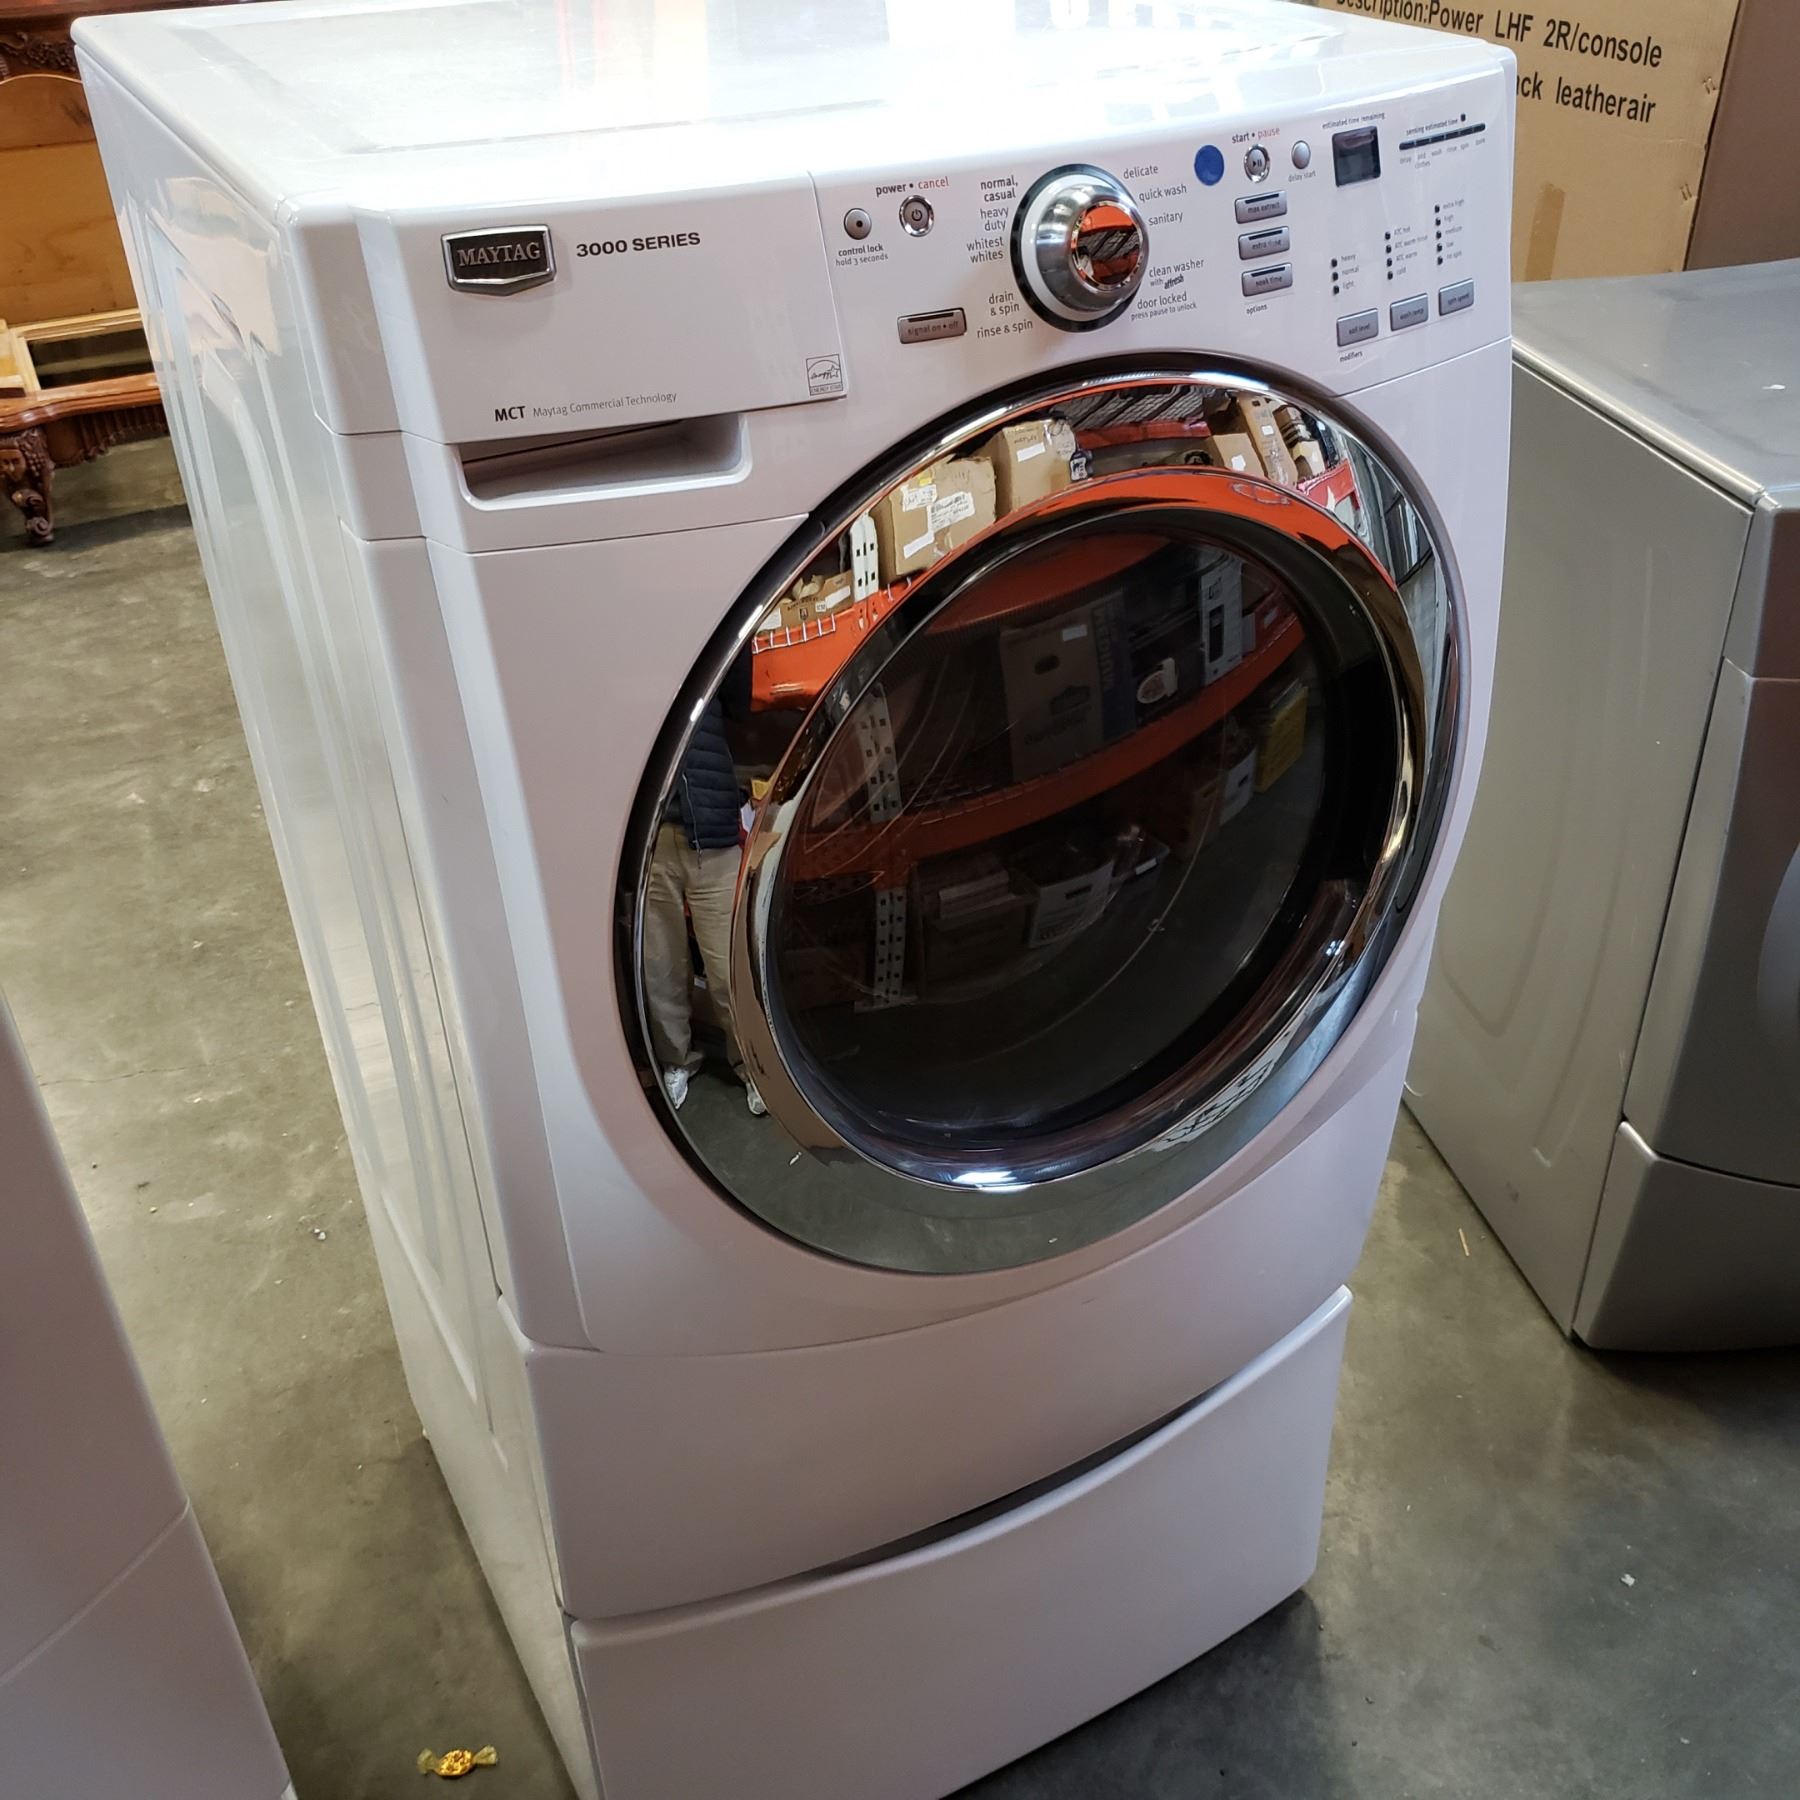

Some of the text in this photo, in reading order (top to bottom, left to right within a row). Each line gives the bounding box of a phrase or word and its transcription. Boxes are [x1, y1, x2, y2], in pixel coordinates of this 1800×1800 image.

[1494, 9, 1534, 42] LHF
[1543, 19, 1662, 68] 2R/console
[1516, 72, 1657, 123] ck leatherair
[1348, 117, 1359, 125] time
[1232, 127, 1280, 144] start pause
[1123, 165, 1158, 180] delicate
[1288, 170, 1316, 182] delay start
[875, 176, 949, 197] power cancel
[980, 175, 1019, 190] normal,
[983, 188, 1016, 202] casual
[1139, 183, 1187, 202] quick wash
[980, 206, 1009, 220] heavy
[1248, 202, 1280, 213] max extract
[984, 218, 1006, 232] duty
[1148, 210, 1183, 226] sanitary
[576, 232, 701, 258] 3000 SERIES
[838, 243, 884, 257] control lock
[966, 236, 1004, 251] whitest
[458, 241, 541, 267] MAYTAG
[835, 253, 889, 267] hold 3 seconds
[970, 249, 1004, 264] whites
[1341, 254, 1356, 263] heavy
[1149, 258, 1205, 278] clean washer
[1342, 266, 1360, 276] normal
[1150, 278, 1164, 286] with
[988, 290, 1014, 305] drain
[1137, 291, 1187, 310] door locked
[990, 302, 1020, 316] & spin
[1131, 301, 1198, 321] press pause to unlock
[1246, 304, 1268, 316] options
[907, 323, 931, 336] signal
[932, 324, 941, 332] on
[977, 319, 1033, 338] rinse & spin
[1340, 350, 1363, 363] modifiers
[494, 392, 677, 422] MCT Maytag Commercial Technology
